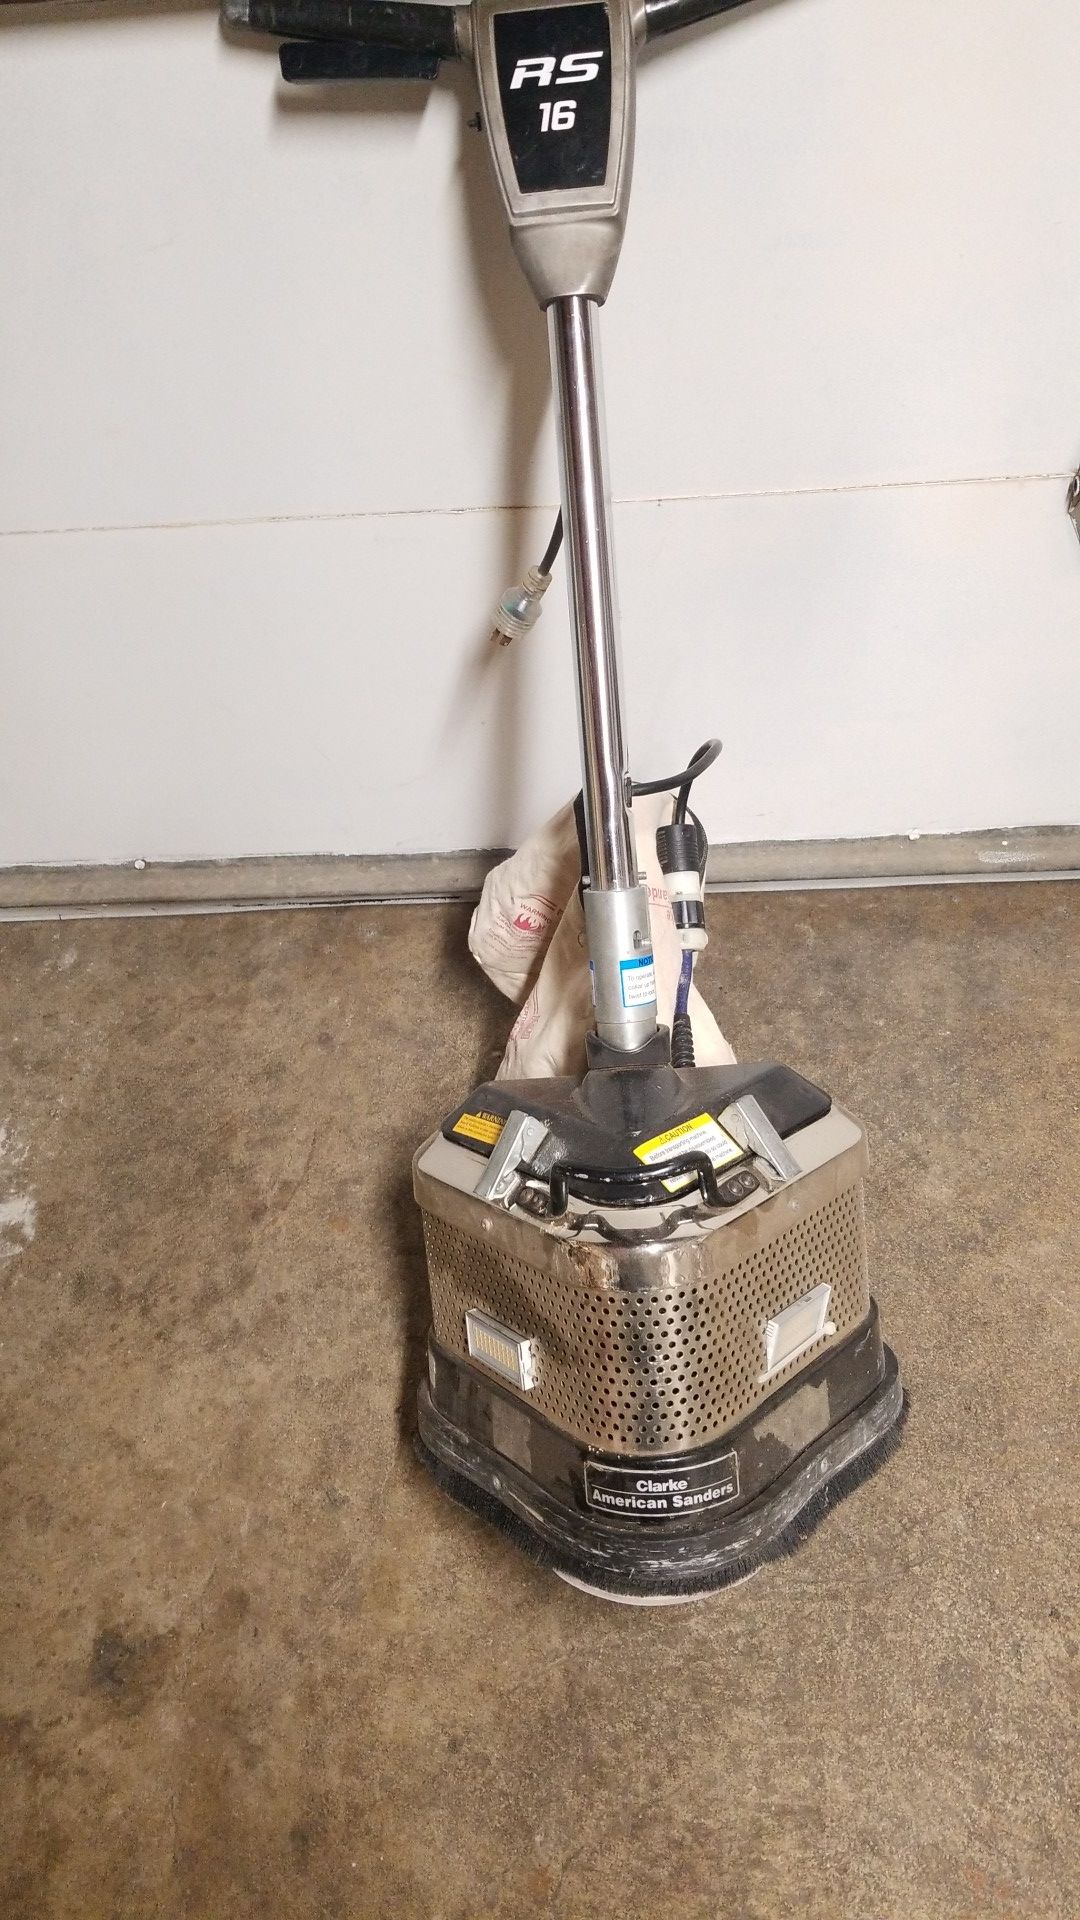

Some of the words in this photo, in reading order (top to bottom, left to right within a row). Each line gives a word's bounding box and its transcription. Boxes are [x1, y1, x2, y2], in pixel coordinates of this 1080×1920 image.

[510, 51, 603, 89] RS
[539, 100, 577, 132] 16
[665, 1123, 693, 1141] CAUTION
[592, 1488, 668, 1509] American
[672, 1482, 733, 1508] Sanders
[636, 1479, 688, 1492] Clarke
